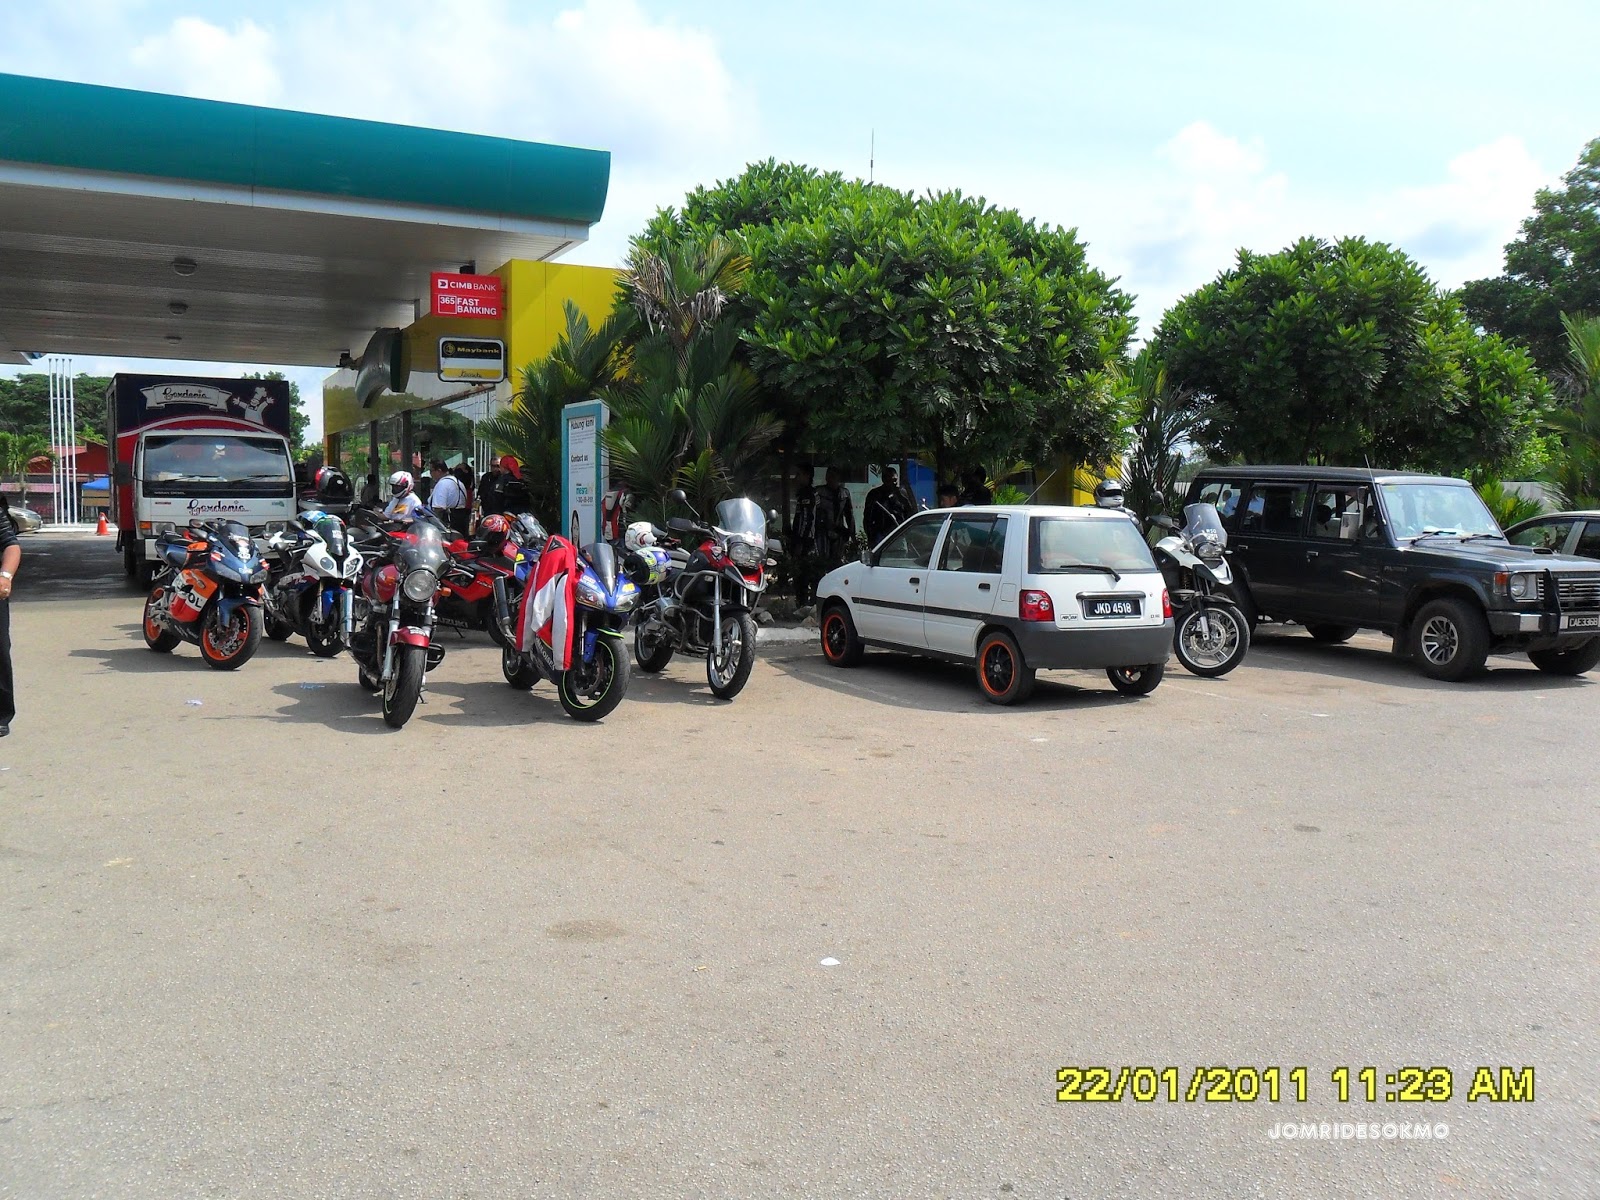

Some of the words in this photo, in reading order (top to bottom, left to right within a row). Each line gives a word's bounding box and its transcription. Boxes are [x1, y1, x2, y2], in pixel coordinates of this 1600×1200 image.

[450, 281, 472, 290] CIMB
[473, 283, 496, 292] BANK
[440, 296, 455, 305] 365
[457, 298, 480, 306] FAST
[457, 306, 497, 316] BANKING
[457, 346, 499, 355] Maybank
[162, 387, 212, 401] Gardenia
[571, 454, 584, 462] Contact
[187, 498, 252, 516] Gardenia
[1094, 602, 1111, 614] JKD
[1112, 602, 1132, 614] 4518
[437, 616, 469, 628] UZUKI
